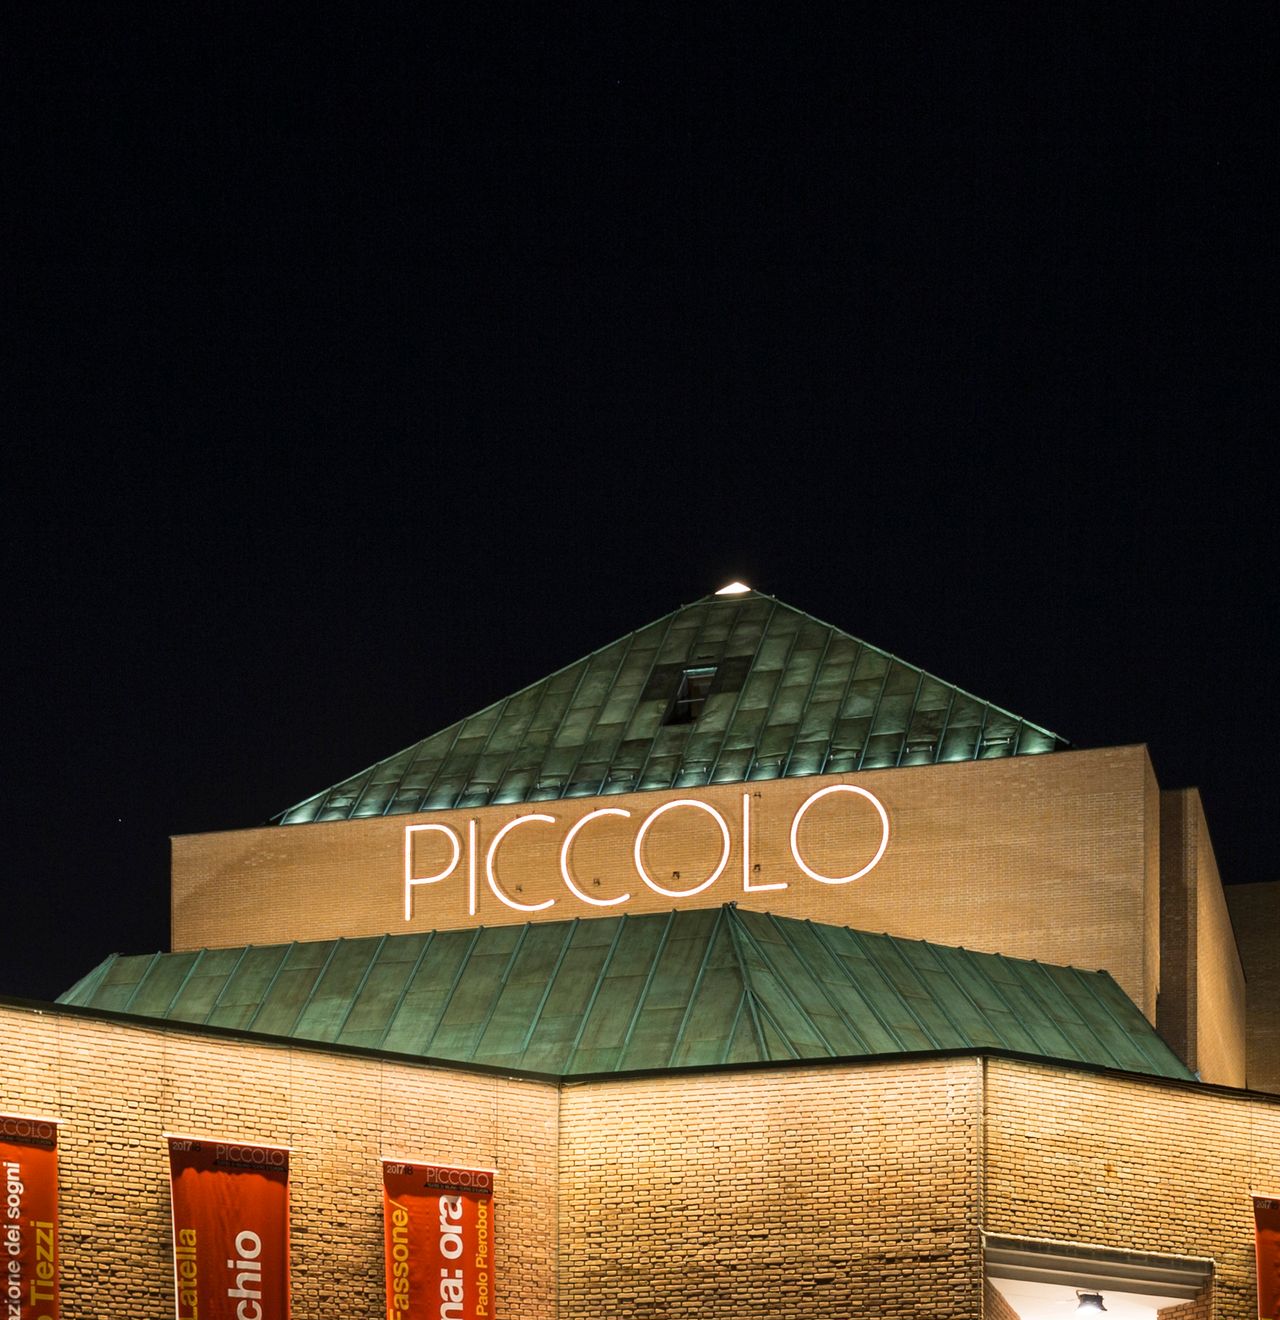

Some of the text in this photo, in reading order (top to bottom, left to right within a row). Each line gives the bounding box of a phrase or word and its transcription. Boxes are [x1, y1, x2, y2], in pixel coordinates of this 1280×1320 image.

[405, 784, 889, 921] PICCOLO
[216, 1144, 285, 1166] PICCOLO
[426, 1167, 490, 1188] PICCOLO
[2, 1162, 24, 1219] sogni
[3, 1223, 20, 1256] dei
[439, 1194, 463, 1260] ora
[30, 1220, 55, 1306] Tiezzi
[476, 1275, 489, 1316] Paolo
